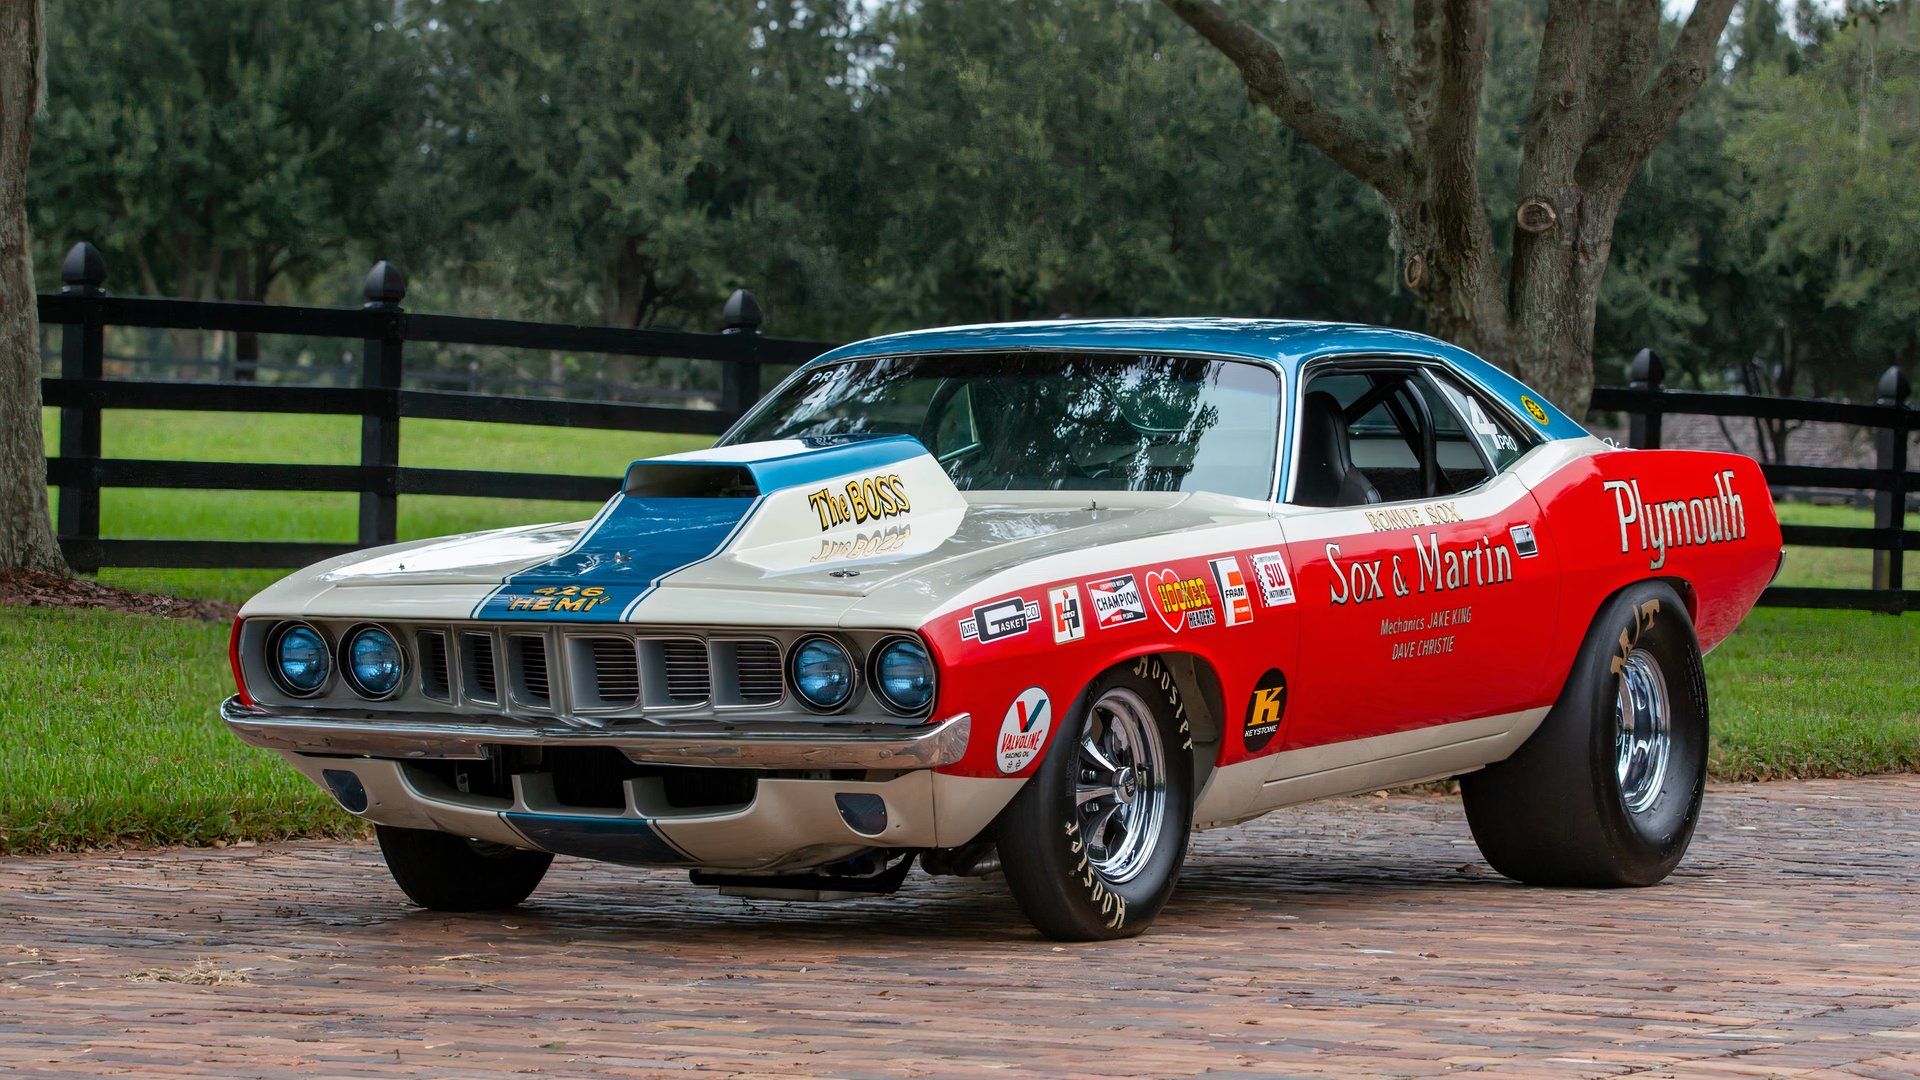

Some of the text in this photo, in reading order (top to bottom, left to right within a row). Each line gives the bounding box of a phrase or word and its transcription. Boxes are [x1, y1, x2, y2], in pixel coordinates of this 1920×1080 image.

[807, 369, 847, 385] PRO
[1466, 395, 1502, 450] 4
[1496, 434, 1517, 451] PRO
[808, 473, 911, 532] The BOSS
[1365, 501, 1464, 533] RONNIE SOX
[1603, 469, 1746, 570] Plymouth
[1264, 562, 1286, 588] SW
[1325, 532, 1513, 606] Sox & Martin
[532, 586, 606, 598] 426
[1096, 590, 1139, 612] CHAMPION
[1157, 577, 1212, 614] HOOKER
[1225, 587, 1245, 599] FRAM
[973, 597, 1028, 642] GASKET
[1187, 609, 1216, 628] HEADERS
[1380, 606, 1472, 636] Mechanics JAKE KING
[1391, 636, 1455, 661] DAVE CHRISTIE
[1247, 686, 1284, 727] K
[1001, 729, 1043, 753] VALVOLINE
[1244, 724, 1278, 738] KEYSTONE
